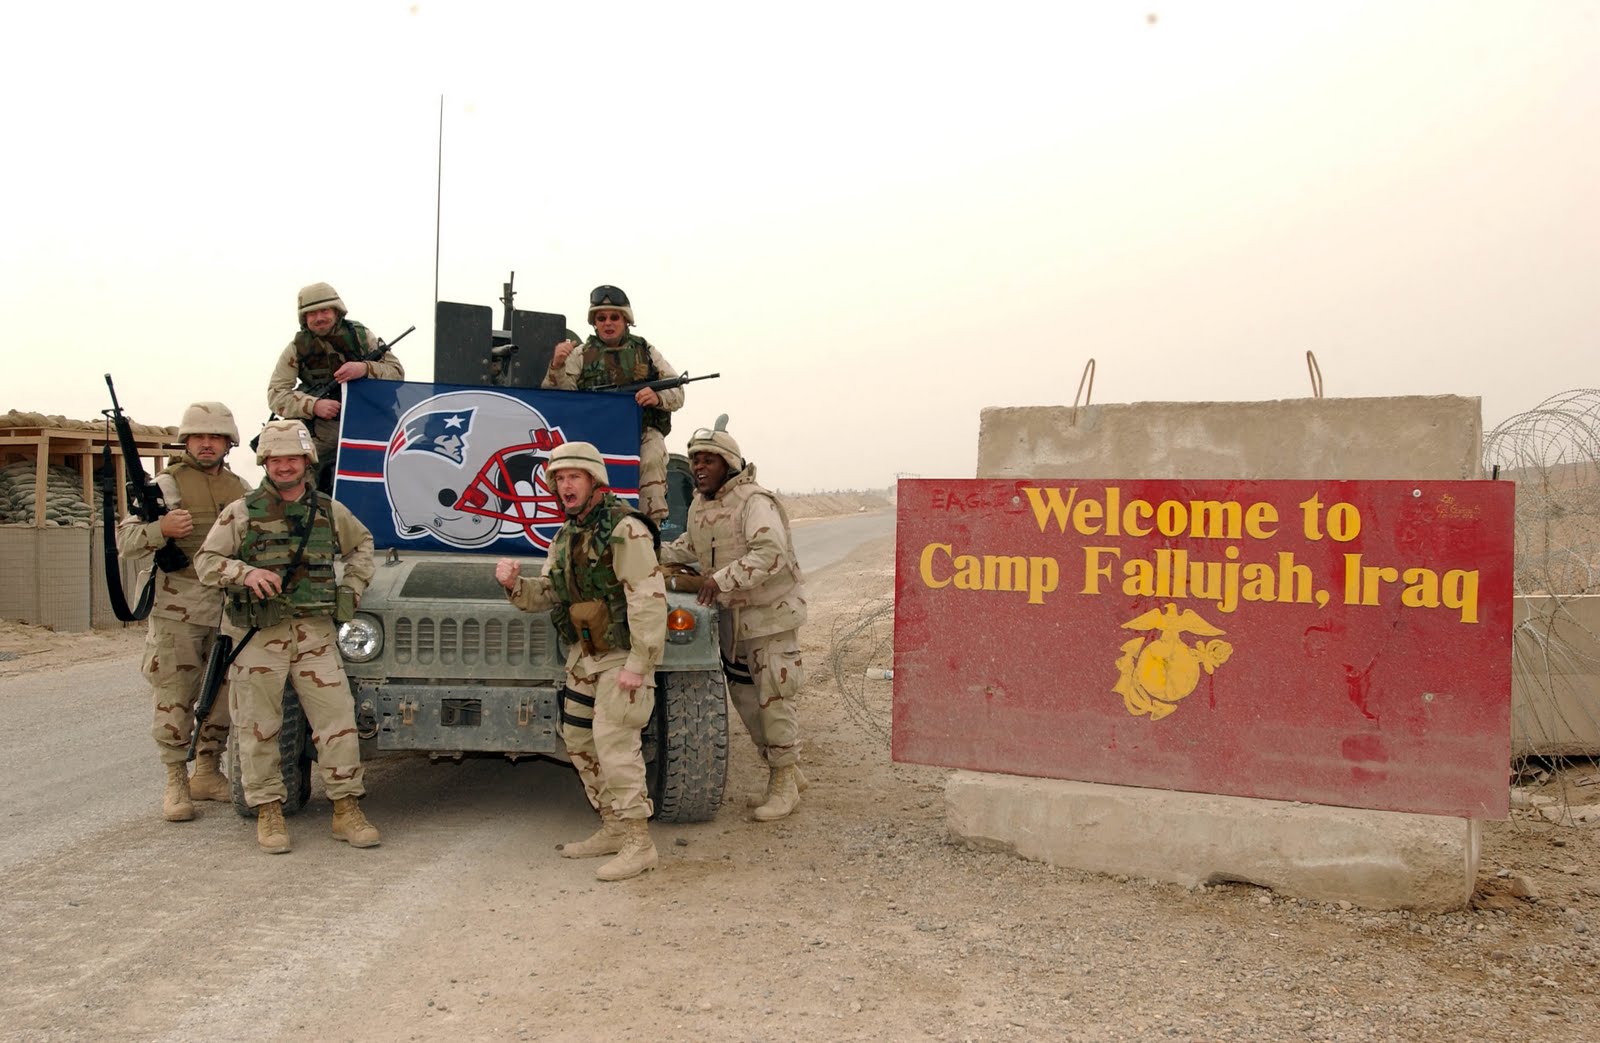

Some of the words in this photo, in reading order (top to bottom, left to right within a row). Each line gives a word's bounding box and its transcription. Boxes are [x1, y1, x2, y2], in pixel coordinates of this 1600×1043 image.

[1023, 486, 1279, 541] Welcome
[1299, 491, 1361, 542] to
[919, 542, 1060, 605] Camp
[1078, 546, 1330, 614] Fallujah,
[1344, 553, 1480, 624] Iraq
